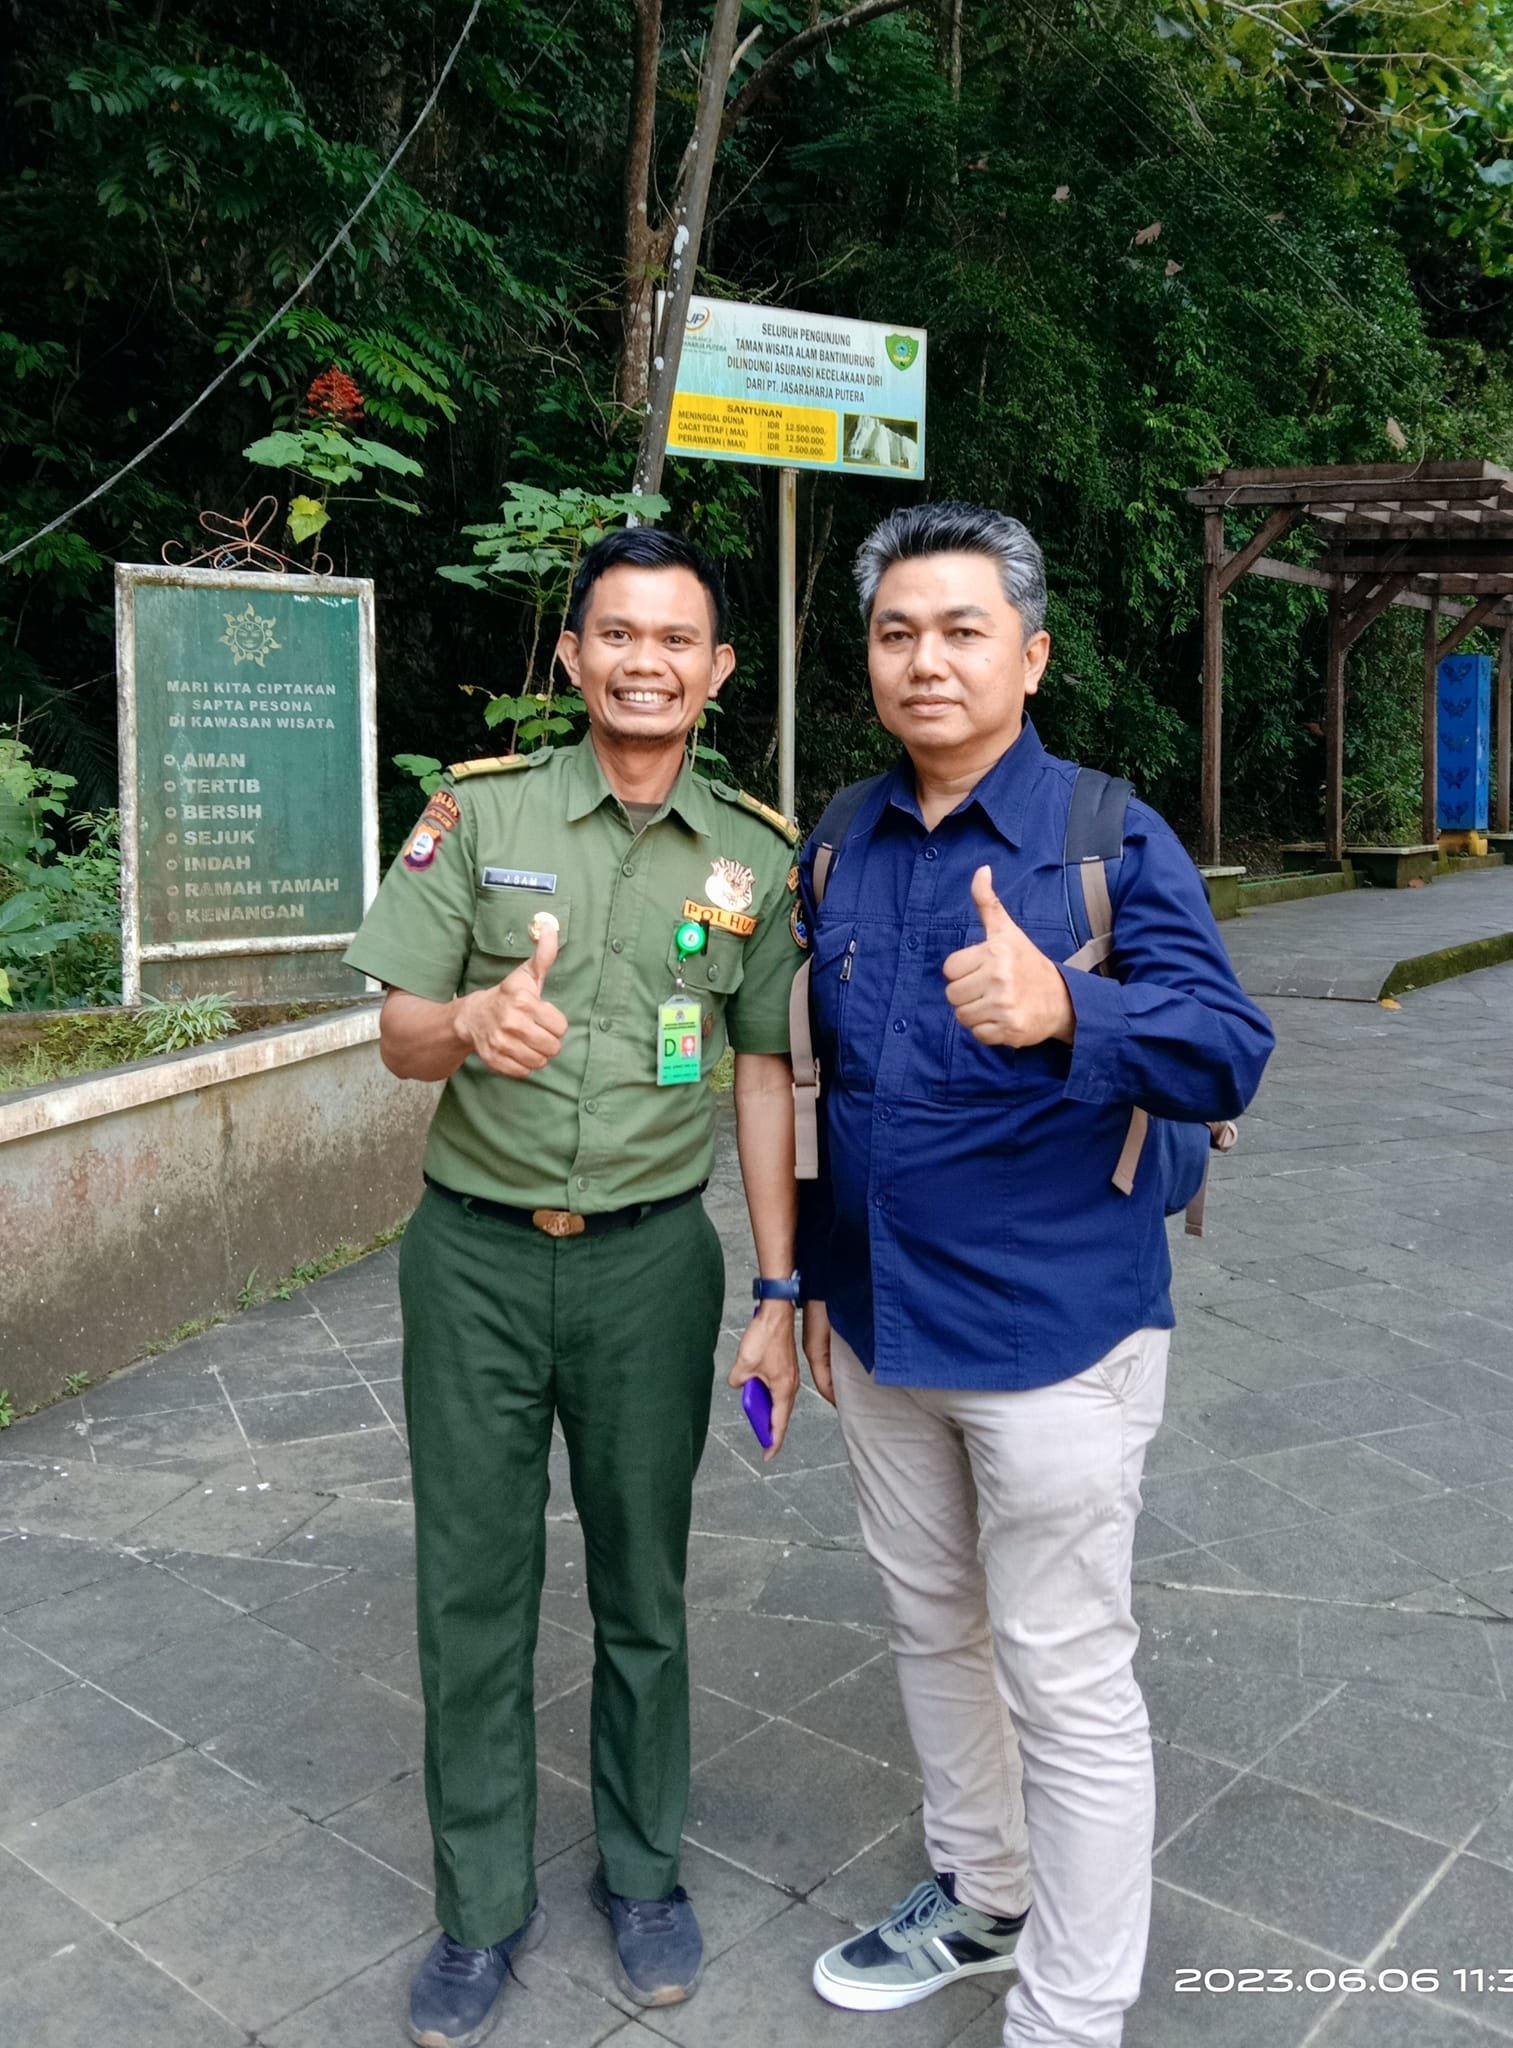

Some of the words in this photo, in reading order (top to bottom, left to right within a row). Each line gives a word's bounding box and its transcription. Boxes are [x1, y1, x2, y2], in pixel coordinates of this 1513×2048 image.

[762, 323, 798, 339] SELURUH
[800, 328, 851, 346] PENGUNJUNG
[736, 338, 763, 353] TAMAN
[765, 342, 793, 357] WISATA
[796, 346, 817, 360] ALAM
[820, 350, 875, 368] BANTIMURUNG
[727, 356, 773, 374] DILINDUNGI
[775, 362, 814, 378] ASURANSI
[816, 367, 865, 384] KECELAKAAN
[867, 374, 883, 388] DIRI
[746, 377, 765, 391] DARI
[767, 381, 779, 393] PT.
[780, 382, 833, 399] JASARAHARJA
[835, 388, 865, 402] PUTERA
[678, 410, 720, 422] MENINGGAL
[722, 416, 744, 425] DUNIA
[768, 421, 780, 430] IDR
[727, 405, 783, 418] SANTUNAN
[678, 422, 700, 432] CACAT
[703, 425, 724, 435] TETAP
[768, 432, 780, 441] IDR
[678, 434, 721, 445] PERAWATAN
[768, 443, 780, 452] IDR
[167, 680, 208, 693] MARI
[214, 681, 250, 694] KITA
[256, 682, 336, 695] CIPTAKAN
[192, 699, 244, 711] SAPTA
[249, 700, 312, 712] PESONA
[168, 716, 185, 728] DI
[191, 716, 271, 728] KAWASAN
[277, 717, 335, 729] WISATA
[183, 753, 245, 768] AMAN
[184, 779, 260, 793] TERTIB
[183, 804, 262, 819] BERSIH
[184, 830, 255, 845] SEJUK
[184, 856, 250, 871] INDAH
[185, 881, 262, 897] RAMAH
[268, 878, 339, 893] TAMAH
[186, 904, 304, 923] KENANGAN
[664, 1038, 677, 1057] D
